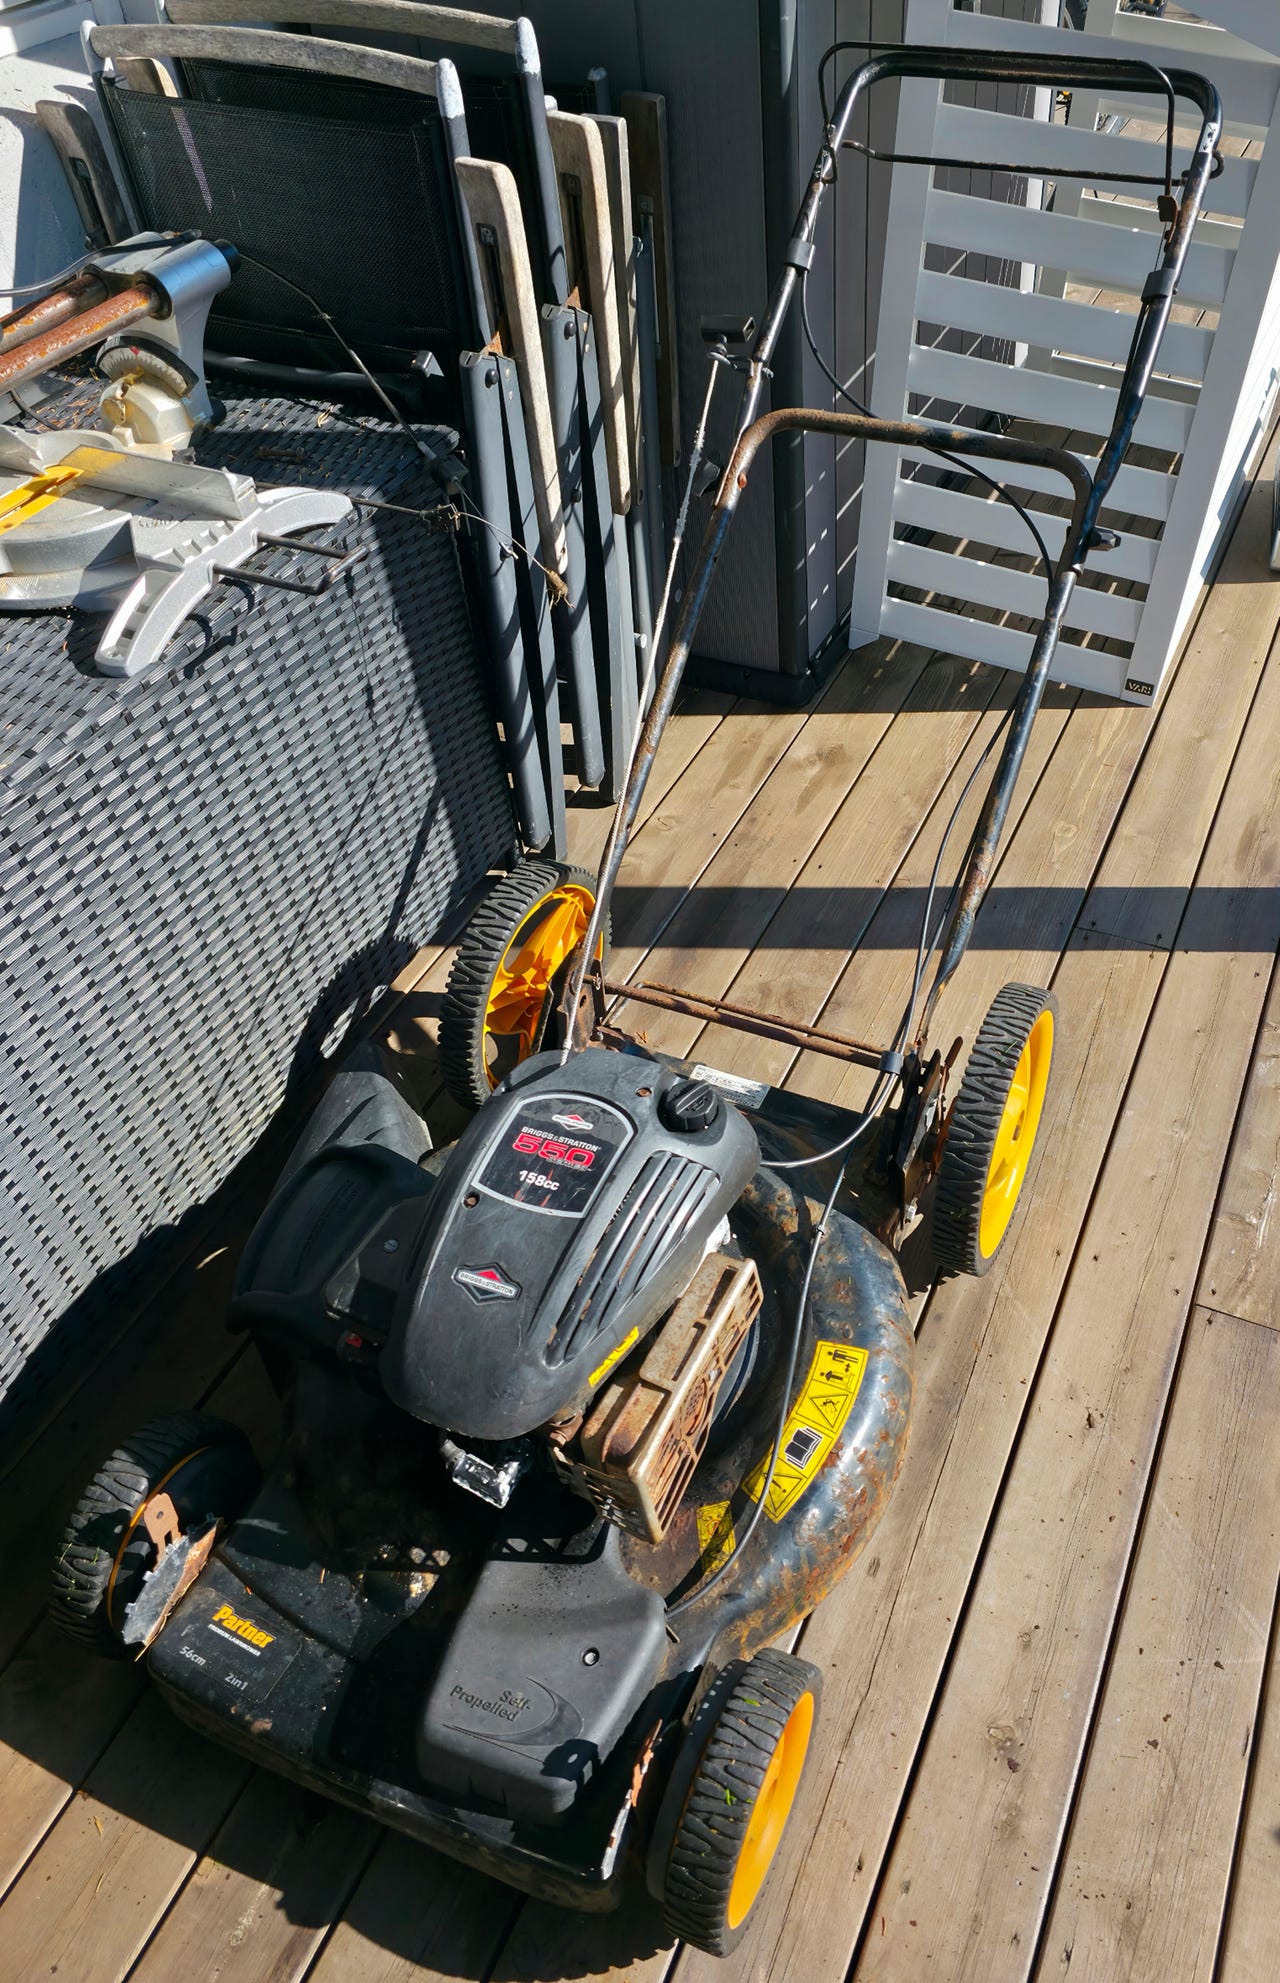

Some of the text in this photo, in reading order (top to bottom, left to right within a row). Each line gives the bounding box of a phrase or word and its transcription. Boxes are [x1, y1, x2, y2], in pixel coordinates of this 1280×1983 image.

[512, 1133, 595, 1168] 550
[519, 1170, 560, 1191] 158cc
[212, 1604, 275, 1648] Partner
[179, 1645, 206, 1666] 56cm
[449, 1685, 520, 1722] Propelled
[499, 1690, 532, 1711] Self-
